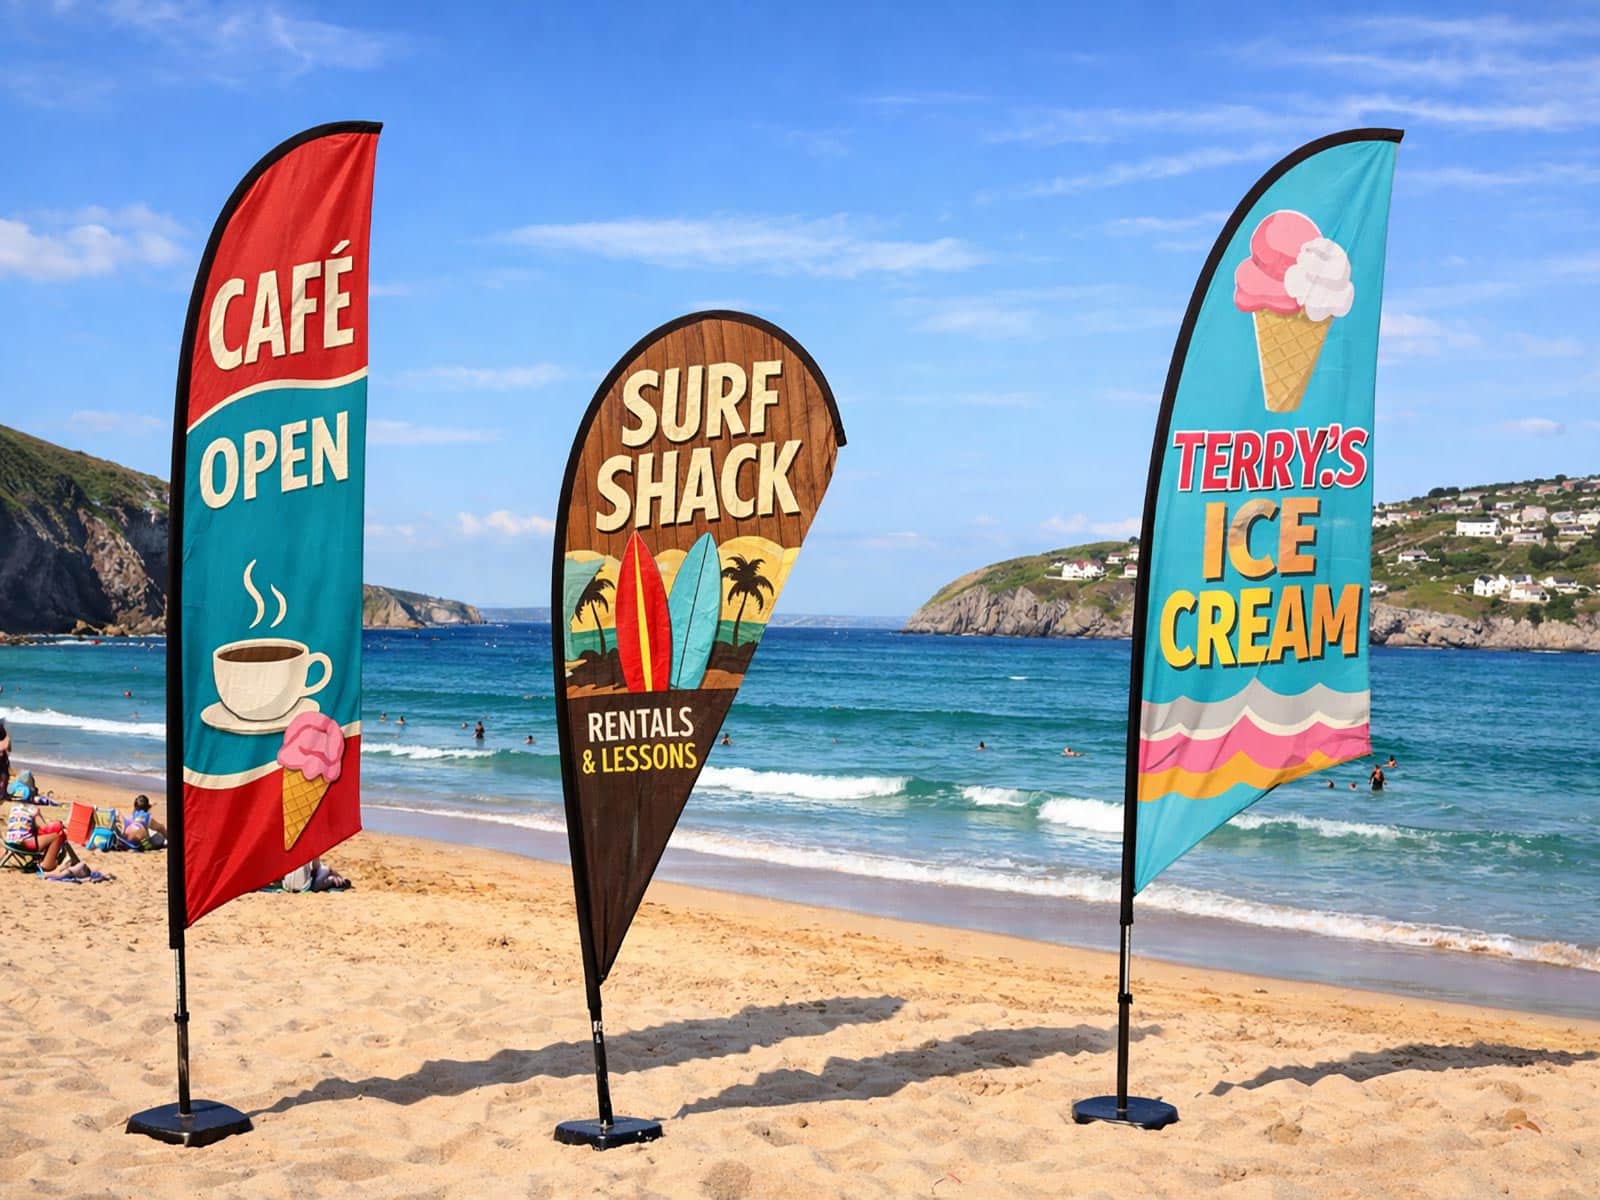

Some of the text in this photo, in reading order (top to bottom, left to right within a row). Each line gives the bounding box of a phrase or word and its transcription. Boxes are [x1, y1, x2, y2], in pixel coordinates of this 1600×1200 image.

[208, 239, 354, 371] CAFÉ
[621, 360, 783, 447] SURF
[200, 410, 349, 510] OPEN
[596, 439, 802, 532] SHACK
[1202, 496, 1321, 581] ICE
[1159, 584, 1362, 669] CREAM
[582, 742, 698, 775] & LESSONS
[587, 706, 695, 743] RENTALS
